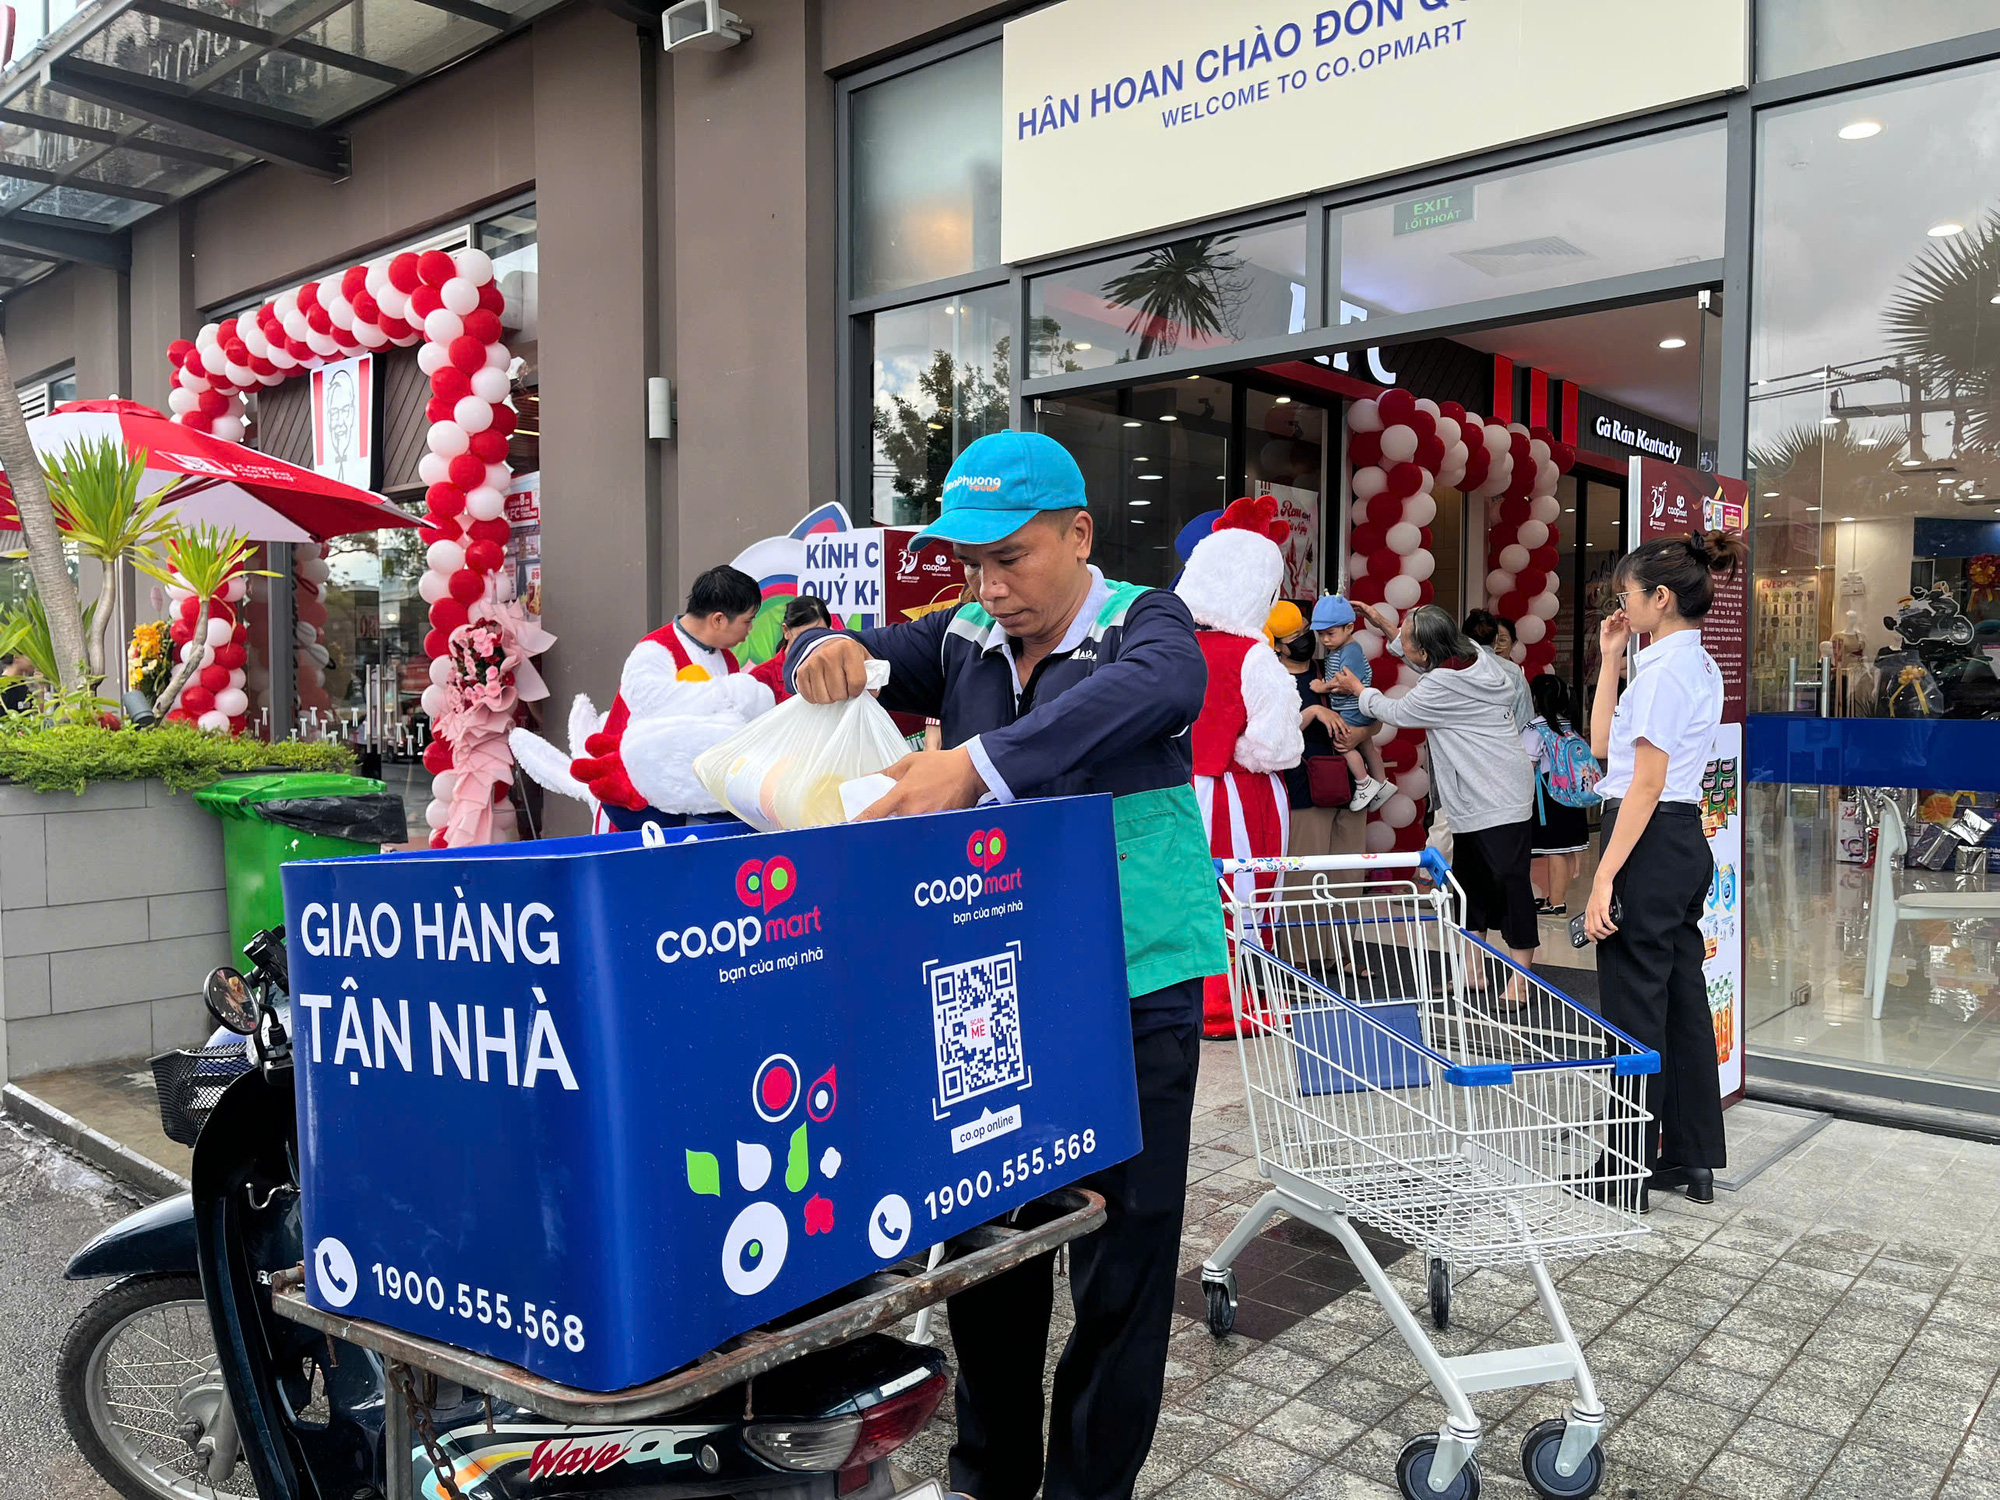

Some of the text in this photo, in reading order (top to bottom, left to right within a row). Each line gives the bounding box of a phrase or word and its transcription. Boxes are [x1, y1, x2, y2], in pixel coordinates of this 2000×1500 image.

[1018, 94, 1080, 141] HÂN
[1090, 59, 1184, 119] HOAN
[1195, 22, 1302, 83] CHÀO
[1161, 18, 1467, 129] WELCOME TO CO.OPMART
[1413, 195, 1453, 216] EXIT
[1424, 209, 1462, 226] THOÁT
[1596, 415, 1682, 465] Gà Rán Kentucky
[806, 536, 858, 569] KÍNH
[914, 867, 1023, 907] co.opmart
[300, 885, 560, 965] GIAO HÀNG
[655, 905, 823, 964] co.opmart
[953, 911, 972, 925] bạn
[973, 906, 990, 920] của
[991, 902, 1006, 918] mọi
[718, 946, 824, 984] bạn của mọi nhà
[299, 976, 580, 1090] TẬN NHÀ
[969, 1017, 985, 1027] SCAN
[971, 1023, 987, 1040] ME
[959, 1113, 1014, 1143] co.op online
[924, 1128, 1097, 1221] 1900.555.568
[371, 1262, 585, 1353] 1900.555.568
[528, 1437, 632, 1482] Wave
